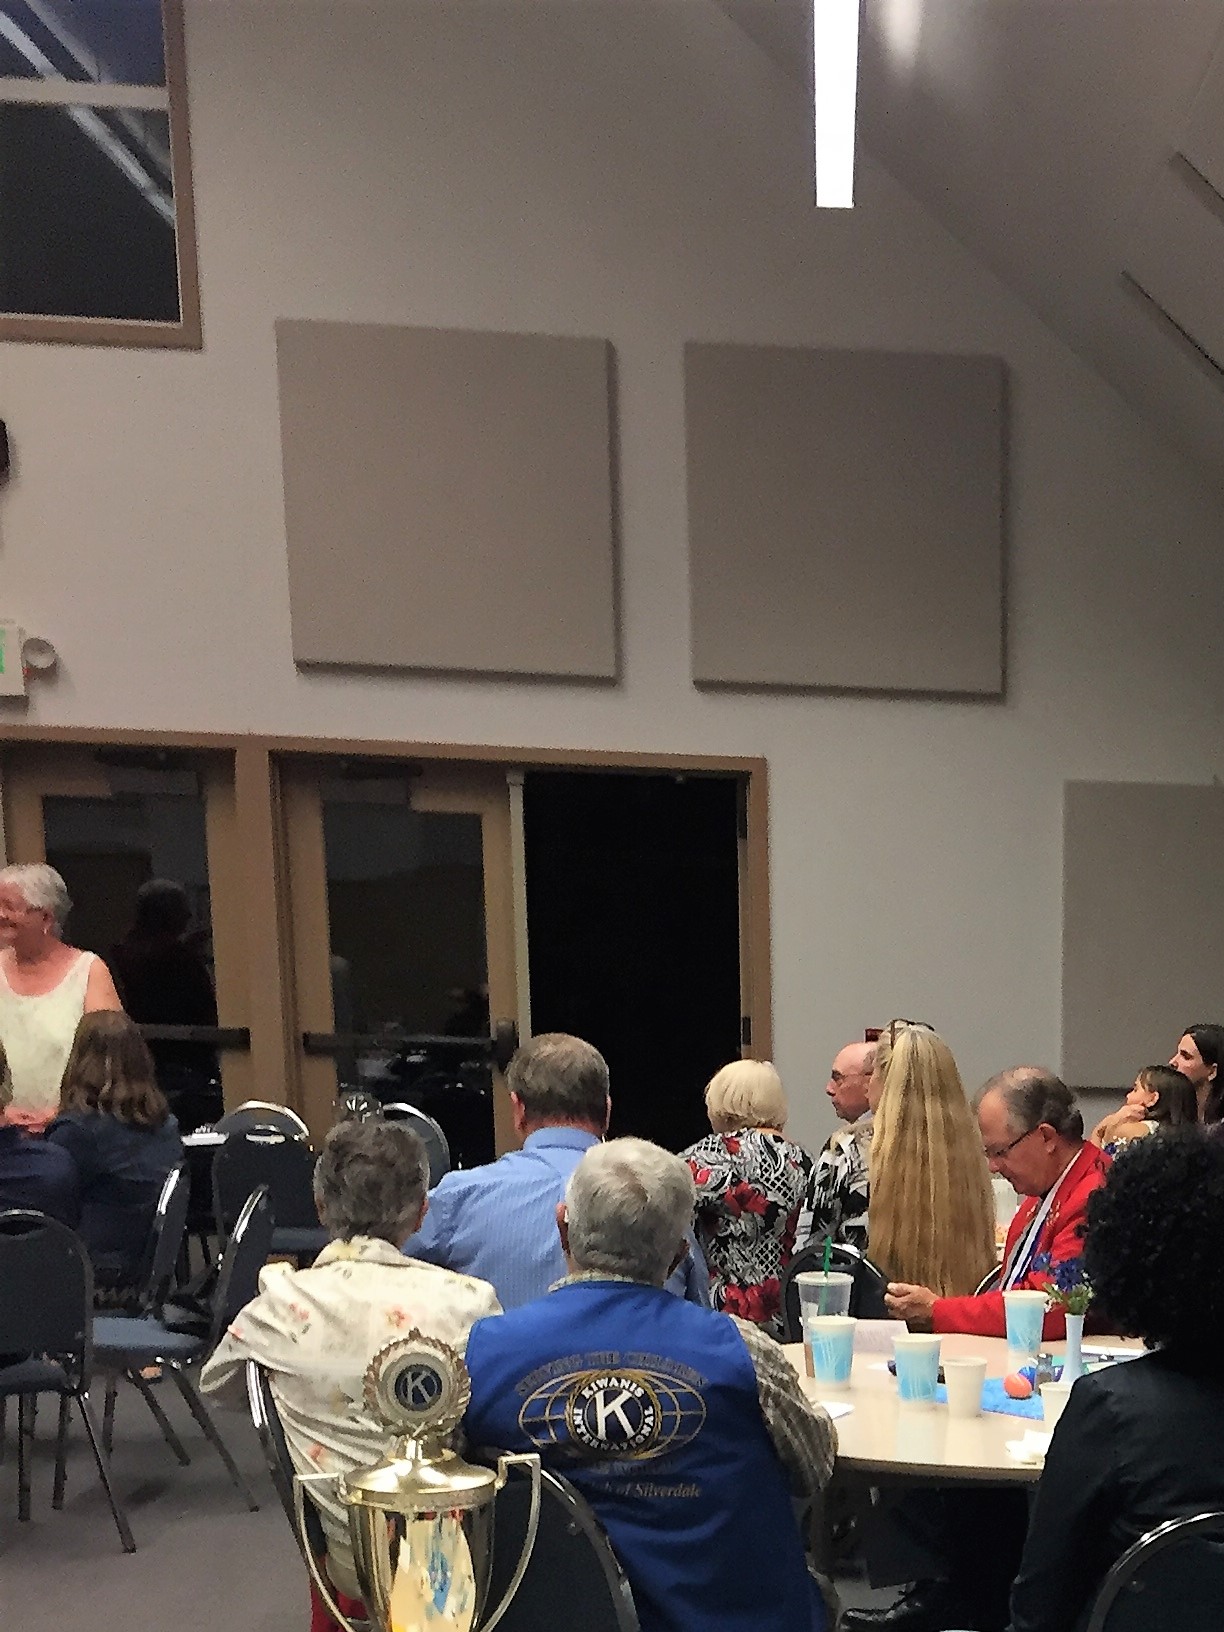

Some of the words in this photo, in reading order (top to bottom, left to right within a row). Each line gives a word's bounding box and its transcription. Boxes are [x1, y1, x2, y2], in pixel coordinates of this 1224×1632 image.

[407, 1371, 433, 1412] K
[581, 1376, 645, 1399] KIWANIS
[572, 1405, 656, 1451] INTERNATIONAL
[593, 1388, 637, 1441] K
[635, 1482, 702, 1498] Silverdale
